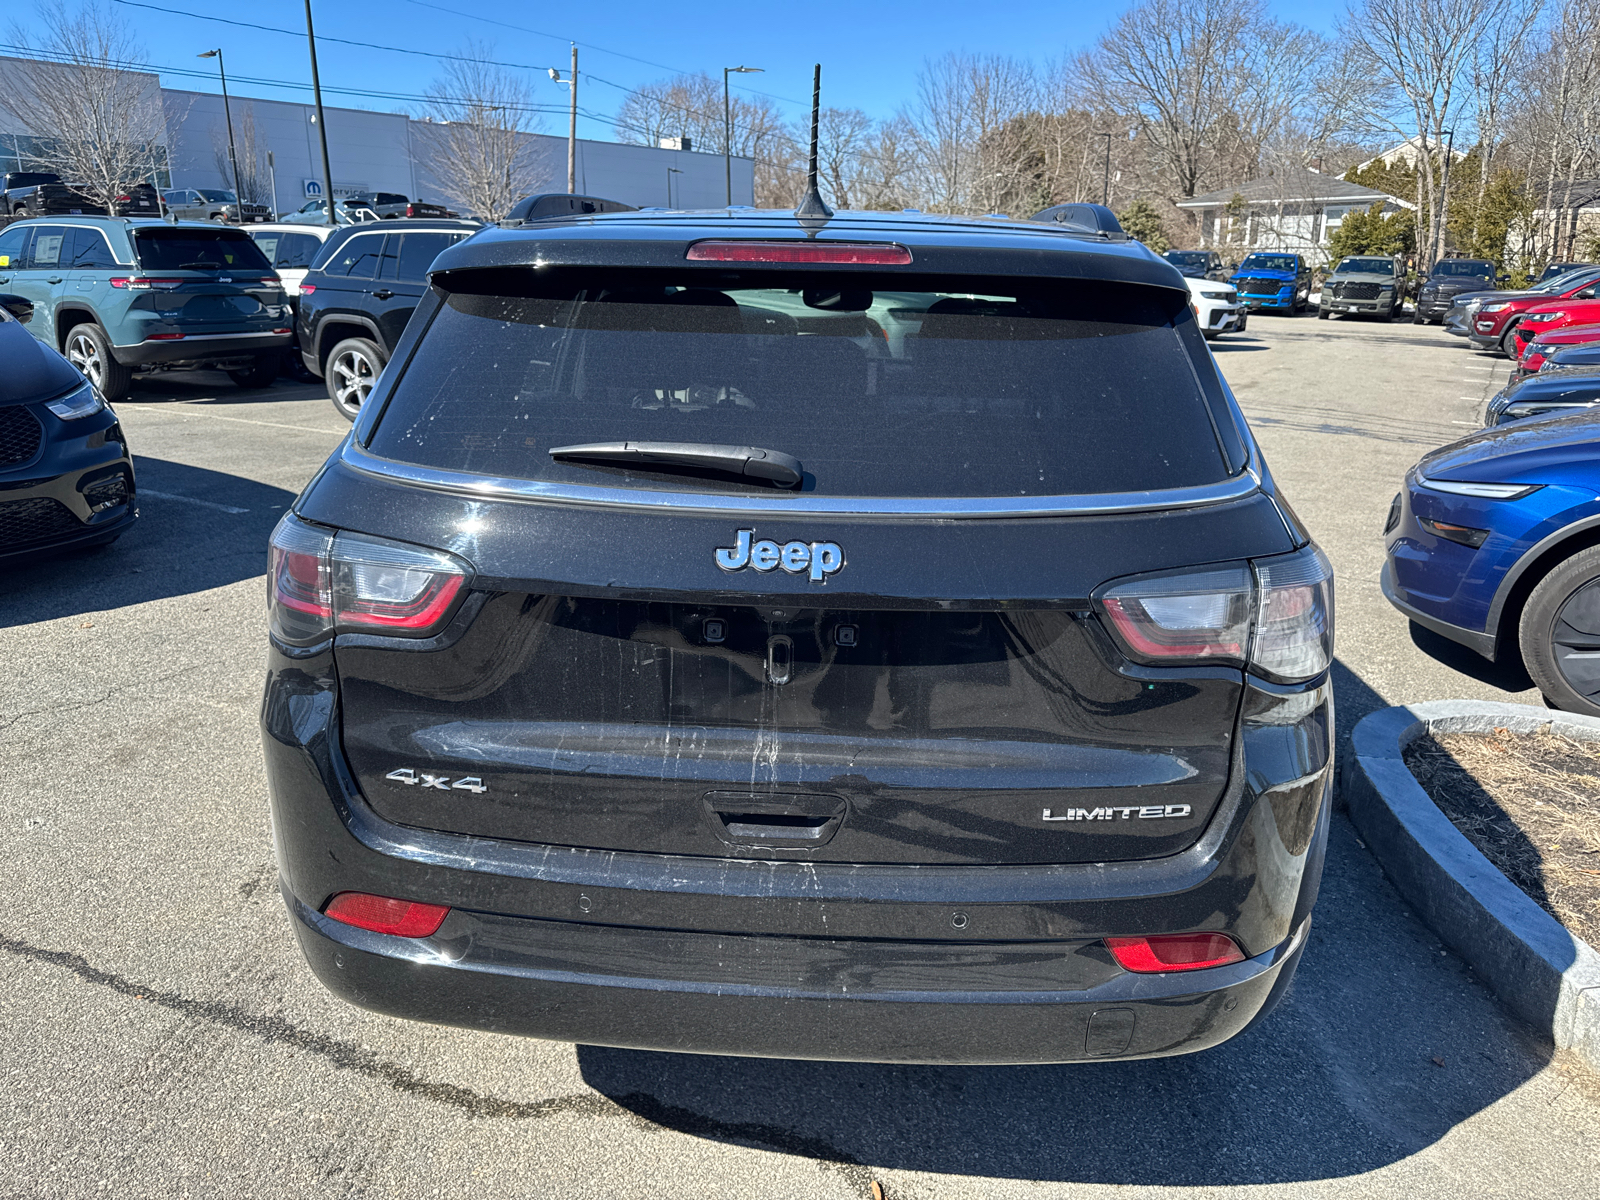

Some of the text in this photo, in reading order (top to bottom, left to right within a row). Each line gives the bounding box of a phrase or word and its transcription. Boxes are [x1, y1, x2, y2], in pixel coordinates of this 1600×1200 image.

[714, 529, 846, 584] Jeep
[385, 768, 488, 794] 4x4
[1042, 803, 1192, 821] LIMITED
